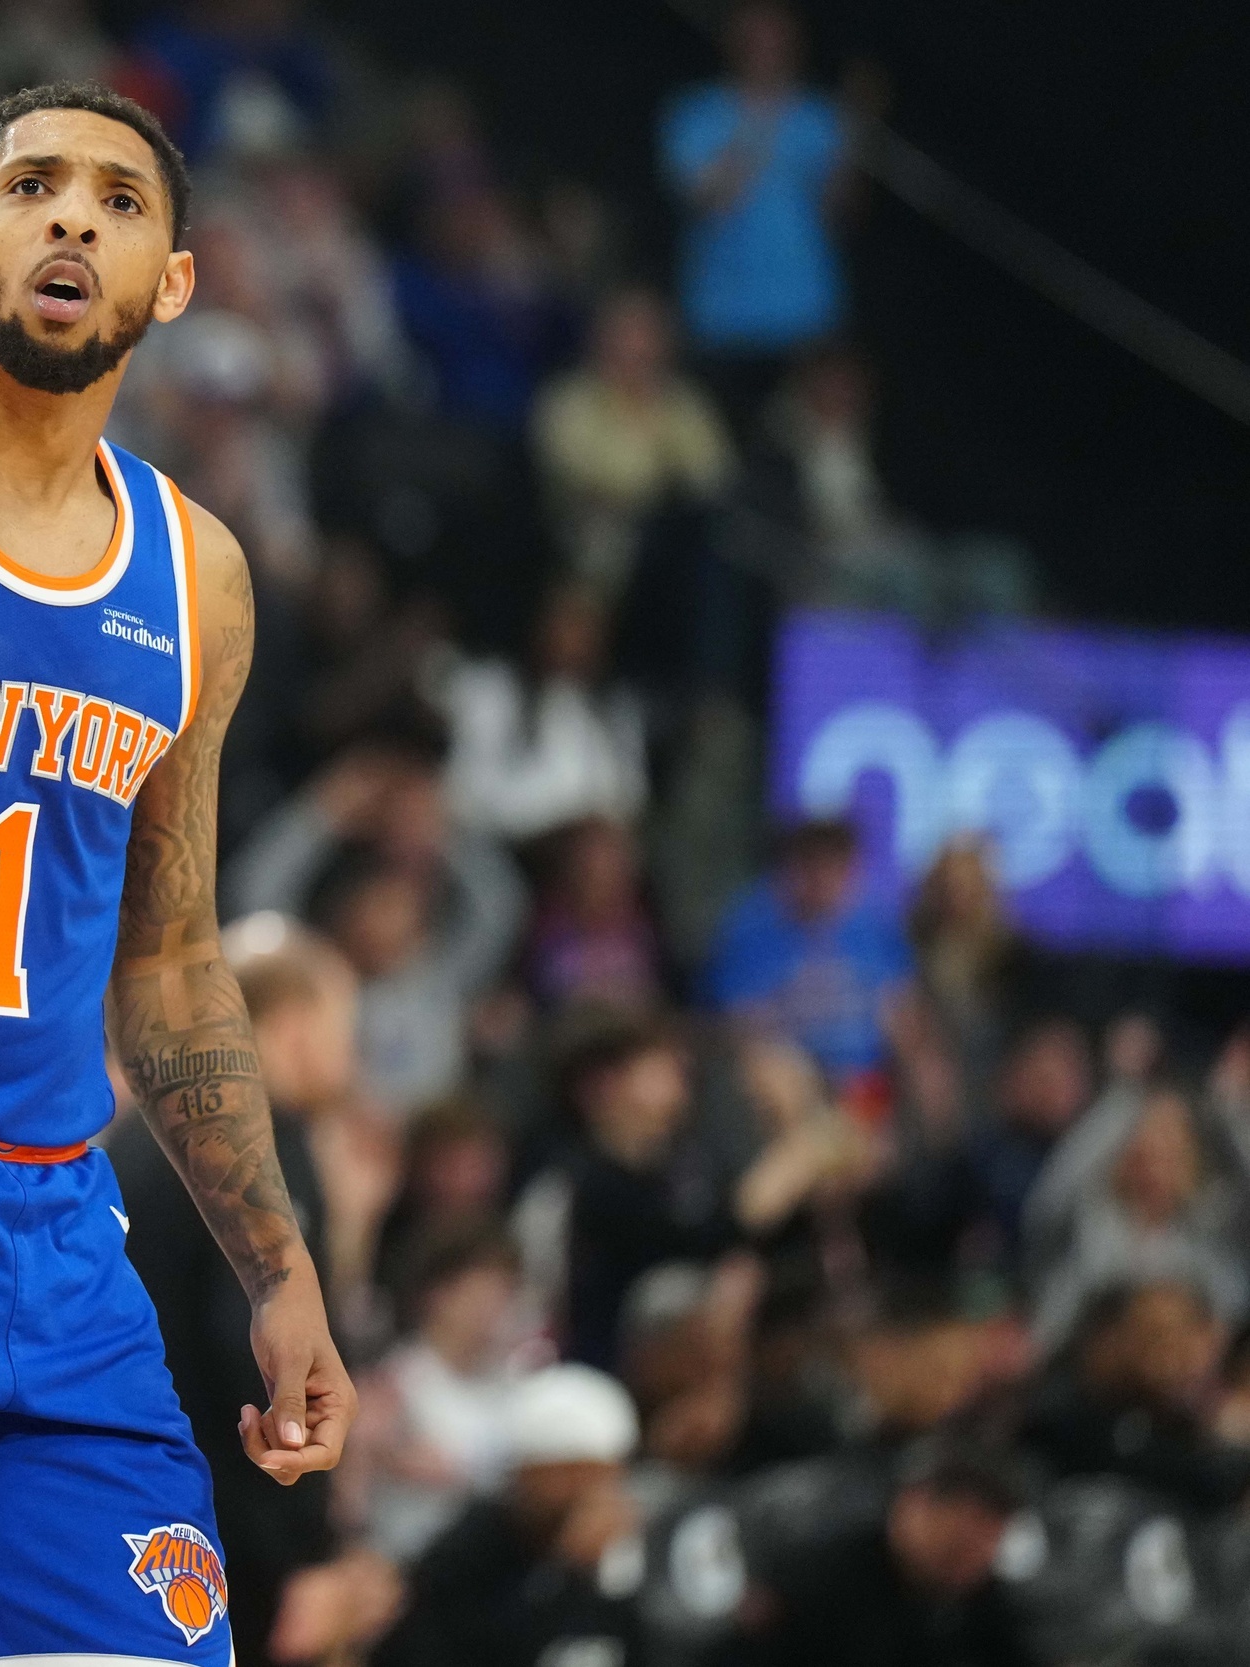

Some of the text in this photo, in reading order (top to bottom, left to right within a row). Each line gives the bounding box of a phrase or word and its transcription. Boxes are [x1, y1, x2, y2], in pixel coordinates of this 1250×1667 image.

[103, 607, 144, 625] experience
[101, 618, 175, 655] abu dhabi
[27, 682, 176, 809] YORK
[177, 1081, 223, 1119] 4:13
[172, 1527, 191, 1539] NEW
[134, 1530, 227, 1608] KNICKS
